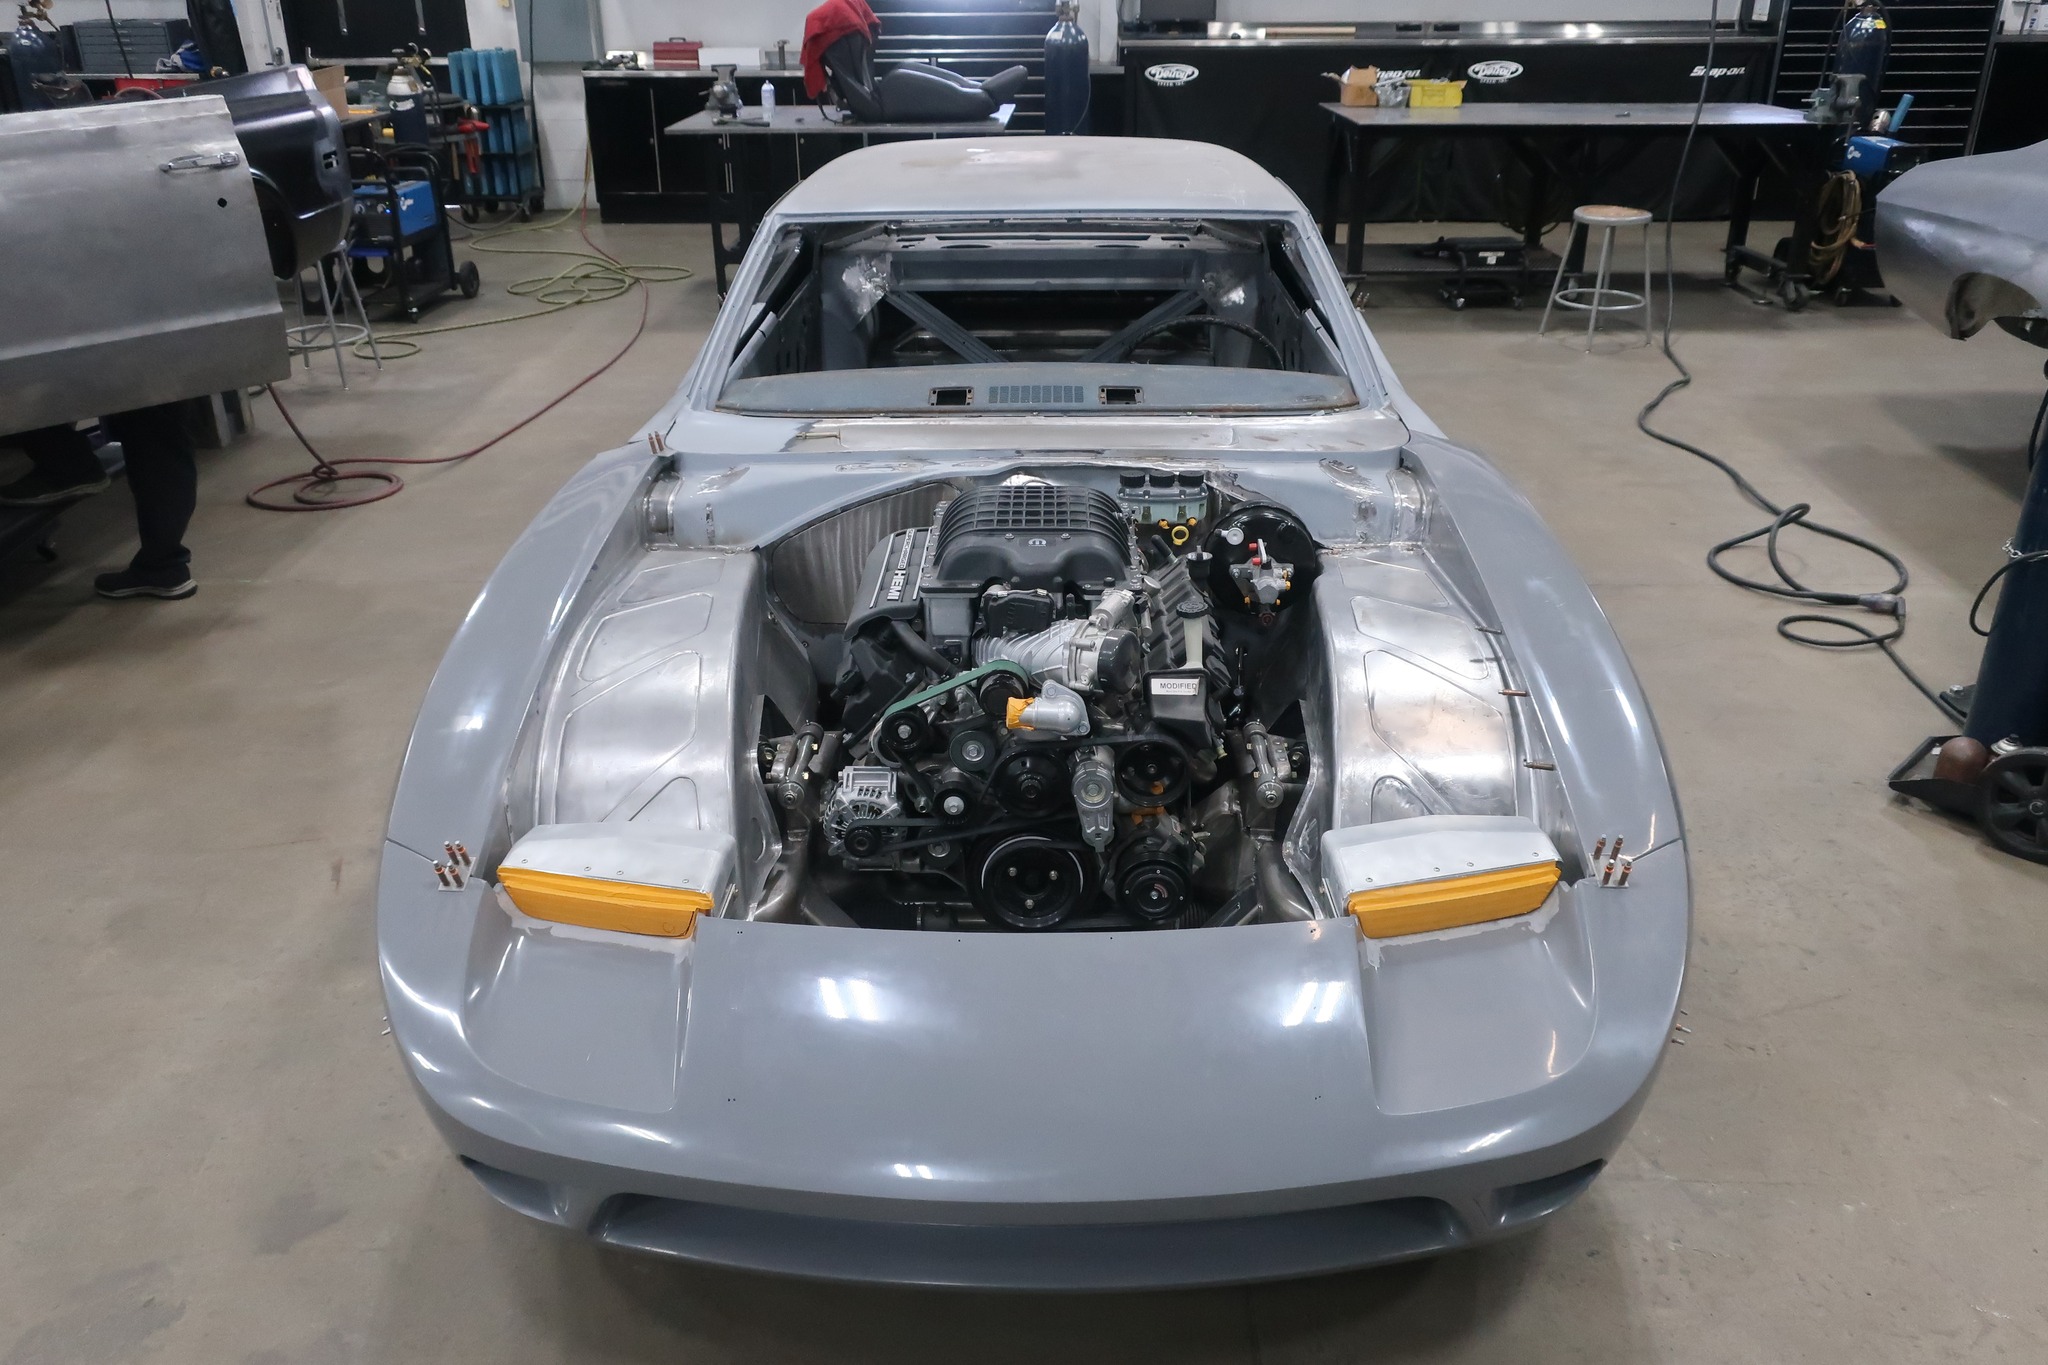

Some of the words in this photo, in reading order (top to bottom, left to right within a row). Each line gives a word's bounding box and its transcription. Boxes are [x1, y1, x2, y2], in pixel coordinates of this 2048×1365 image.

[1375, 68, 1421, 79] nap-on
[886, 570, 906, 600] HEMI
[1159, 682, 1198, 690] MODIFIED
